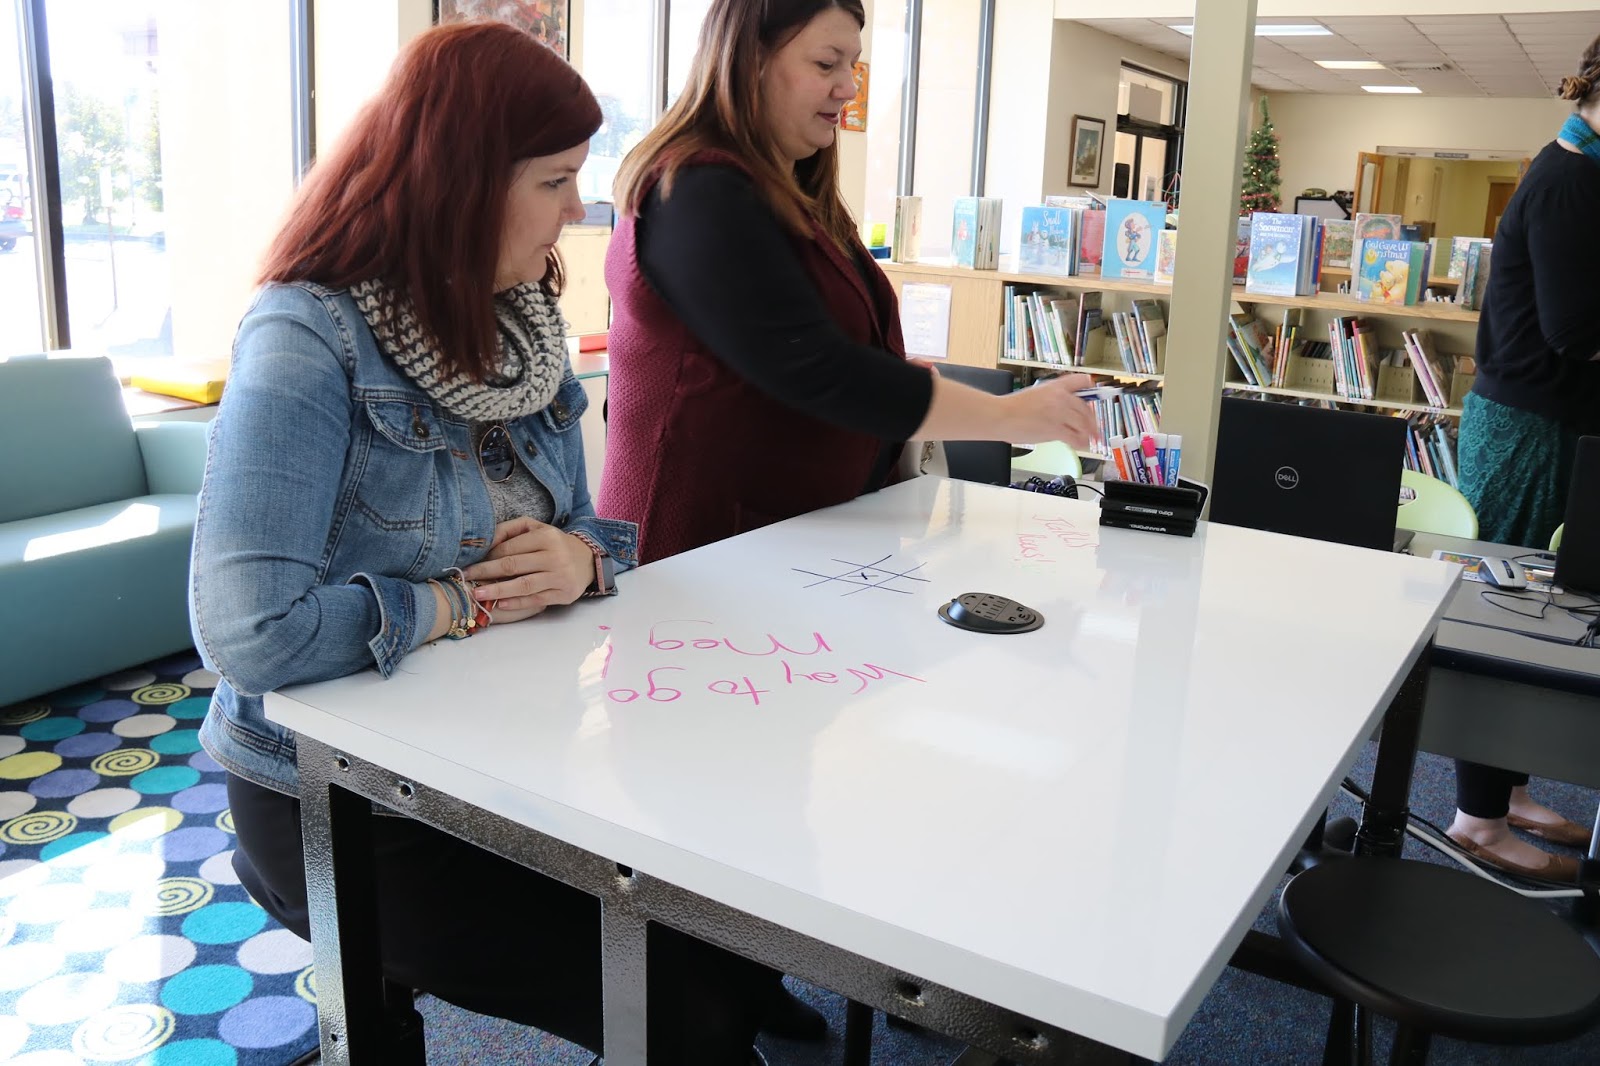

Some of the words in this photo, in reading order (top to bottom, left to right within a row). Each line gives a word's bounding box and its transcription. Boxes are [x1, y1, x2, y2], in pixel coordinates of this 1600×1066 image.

[1272, 217, 1282, 225] The
[1259, 222, 1295, 233] Snowman
[1379, 241, 1397, 252] Gave
[1278, 473, 1297, 483] DELL
[648, 619, 833, 656] Meg
[607, 666, 686, 703] go
[707, 676, 771, 706] to
